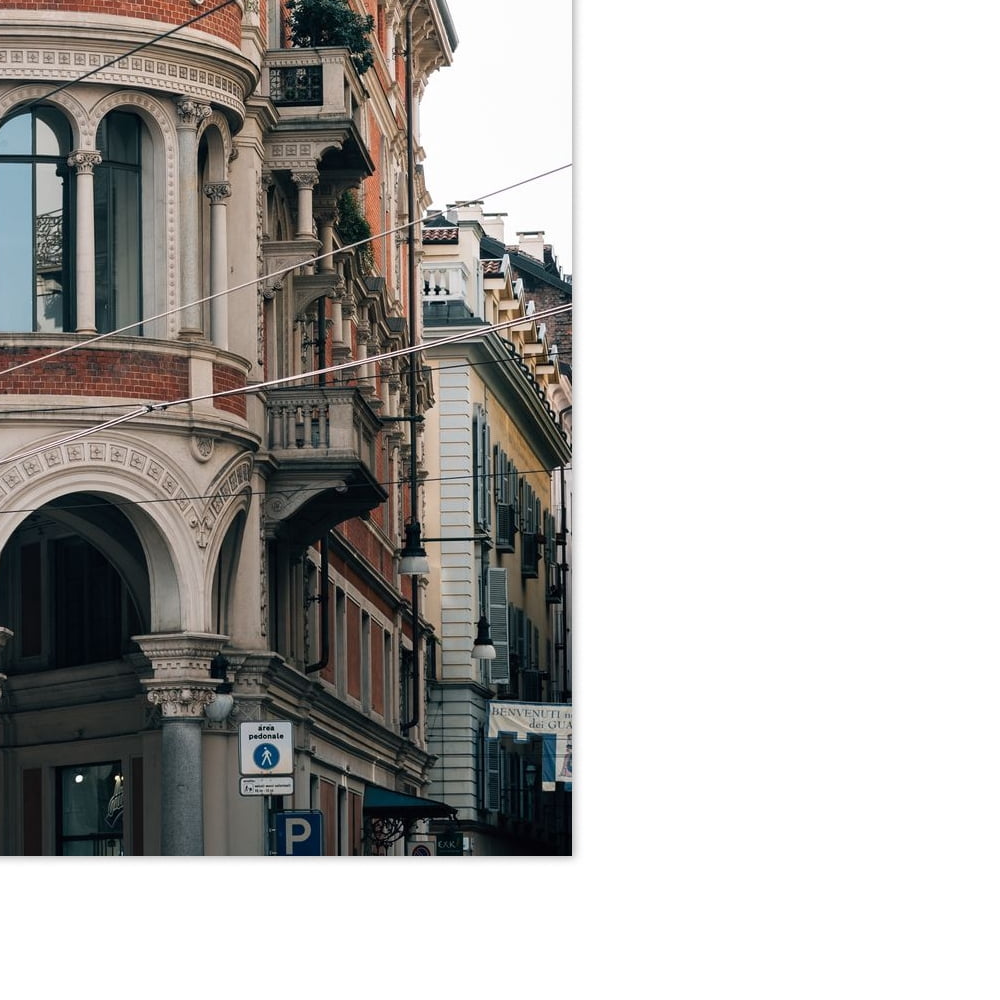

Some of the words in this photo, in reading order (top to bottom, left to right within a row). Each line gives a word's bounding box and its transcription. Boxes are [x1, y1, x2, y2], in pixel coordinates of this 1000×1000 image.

[492, 707, 560, 718] BENVENUTI
[529, 718, 544, 729] dei
[249, 732, 284, 740] pedonale
[285, 818, 312, 855] P
